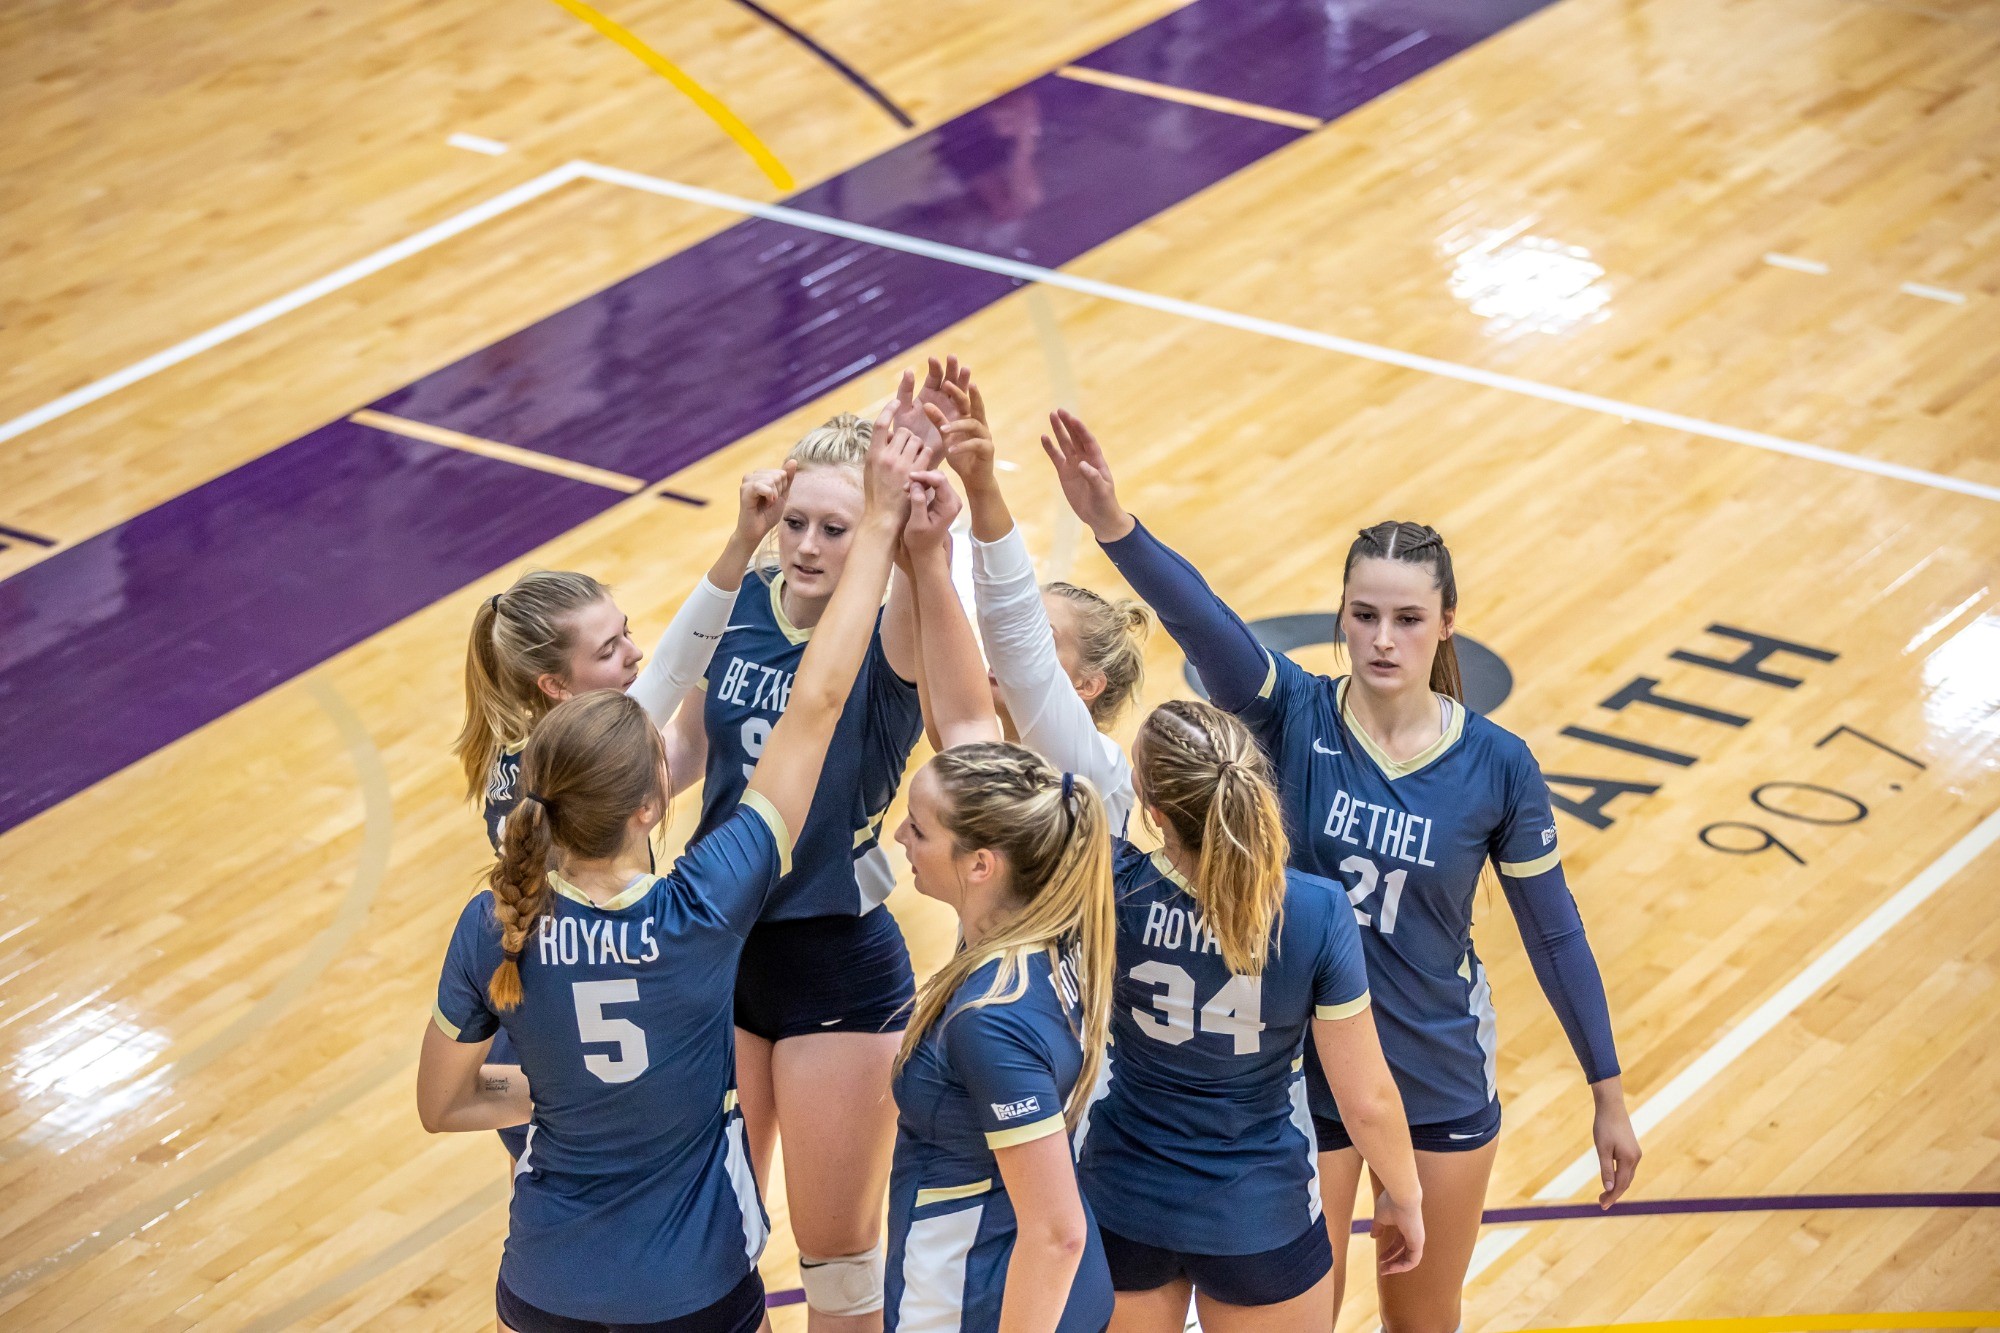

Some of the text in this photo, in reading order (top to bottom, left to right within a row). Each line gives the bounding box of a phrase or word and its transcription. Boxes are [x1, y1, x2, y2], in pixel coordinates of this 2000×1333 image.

[717, 656, 797, 713] BETHE
[1543, 621, 1841, 831] AITH
[1323, 789, 1436, 868] BETHEL
[1698, 724, 1928, 867] 90.7
[1142, 901, 1223, 956] ROYA
[1338, 854, 1408, 935] 21
[539, 915, 660, 966] ROYALS
[571, 978, 650, 1084] 5
[1129, 960, 1267, 1056] 34
[997, 1098, 1039, 1119] MIAC
